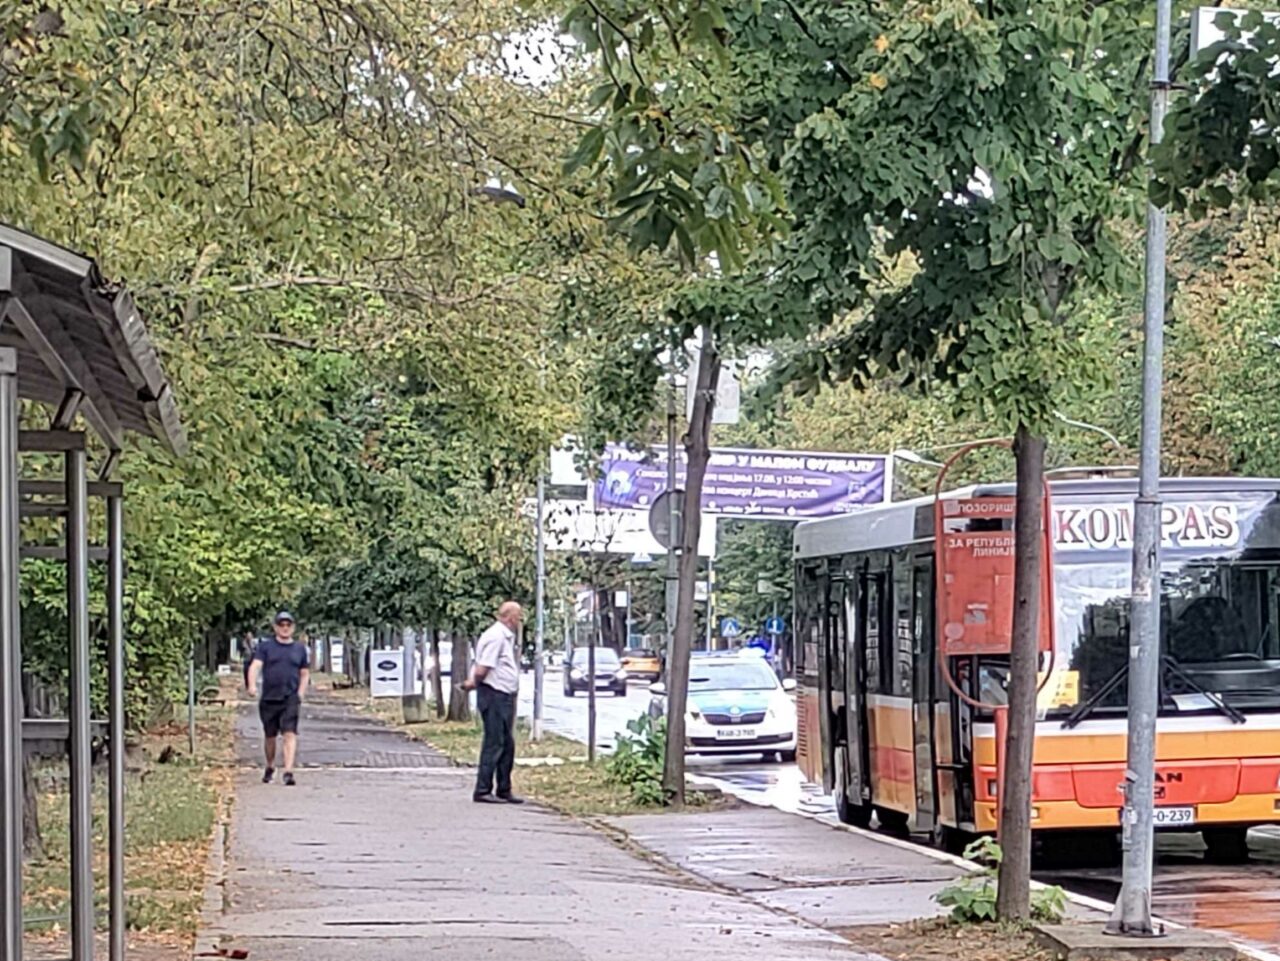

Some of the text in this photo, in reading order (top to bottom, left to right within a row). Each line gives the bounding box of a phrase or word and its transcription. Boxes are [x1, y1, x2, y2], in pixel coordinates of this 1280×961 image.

[958, 503, 1016, 513] ПОЗОРИШ
[948, 537, 1016, 549] ЗА РЕПУБЛ
[1154, 772, 1183, 783] AN
